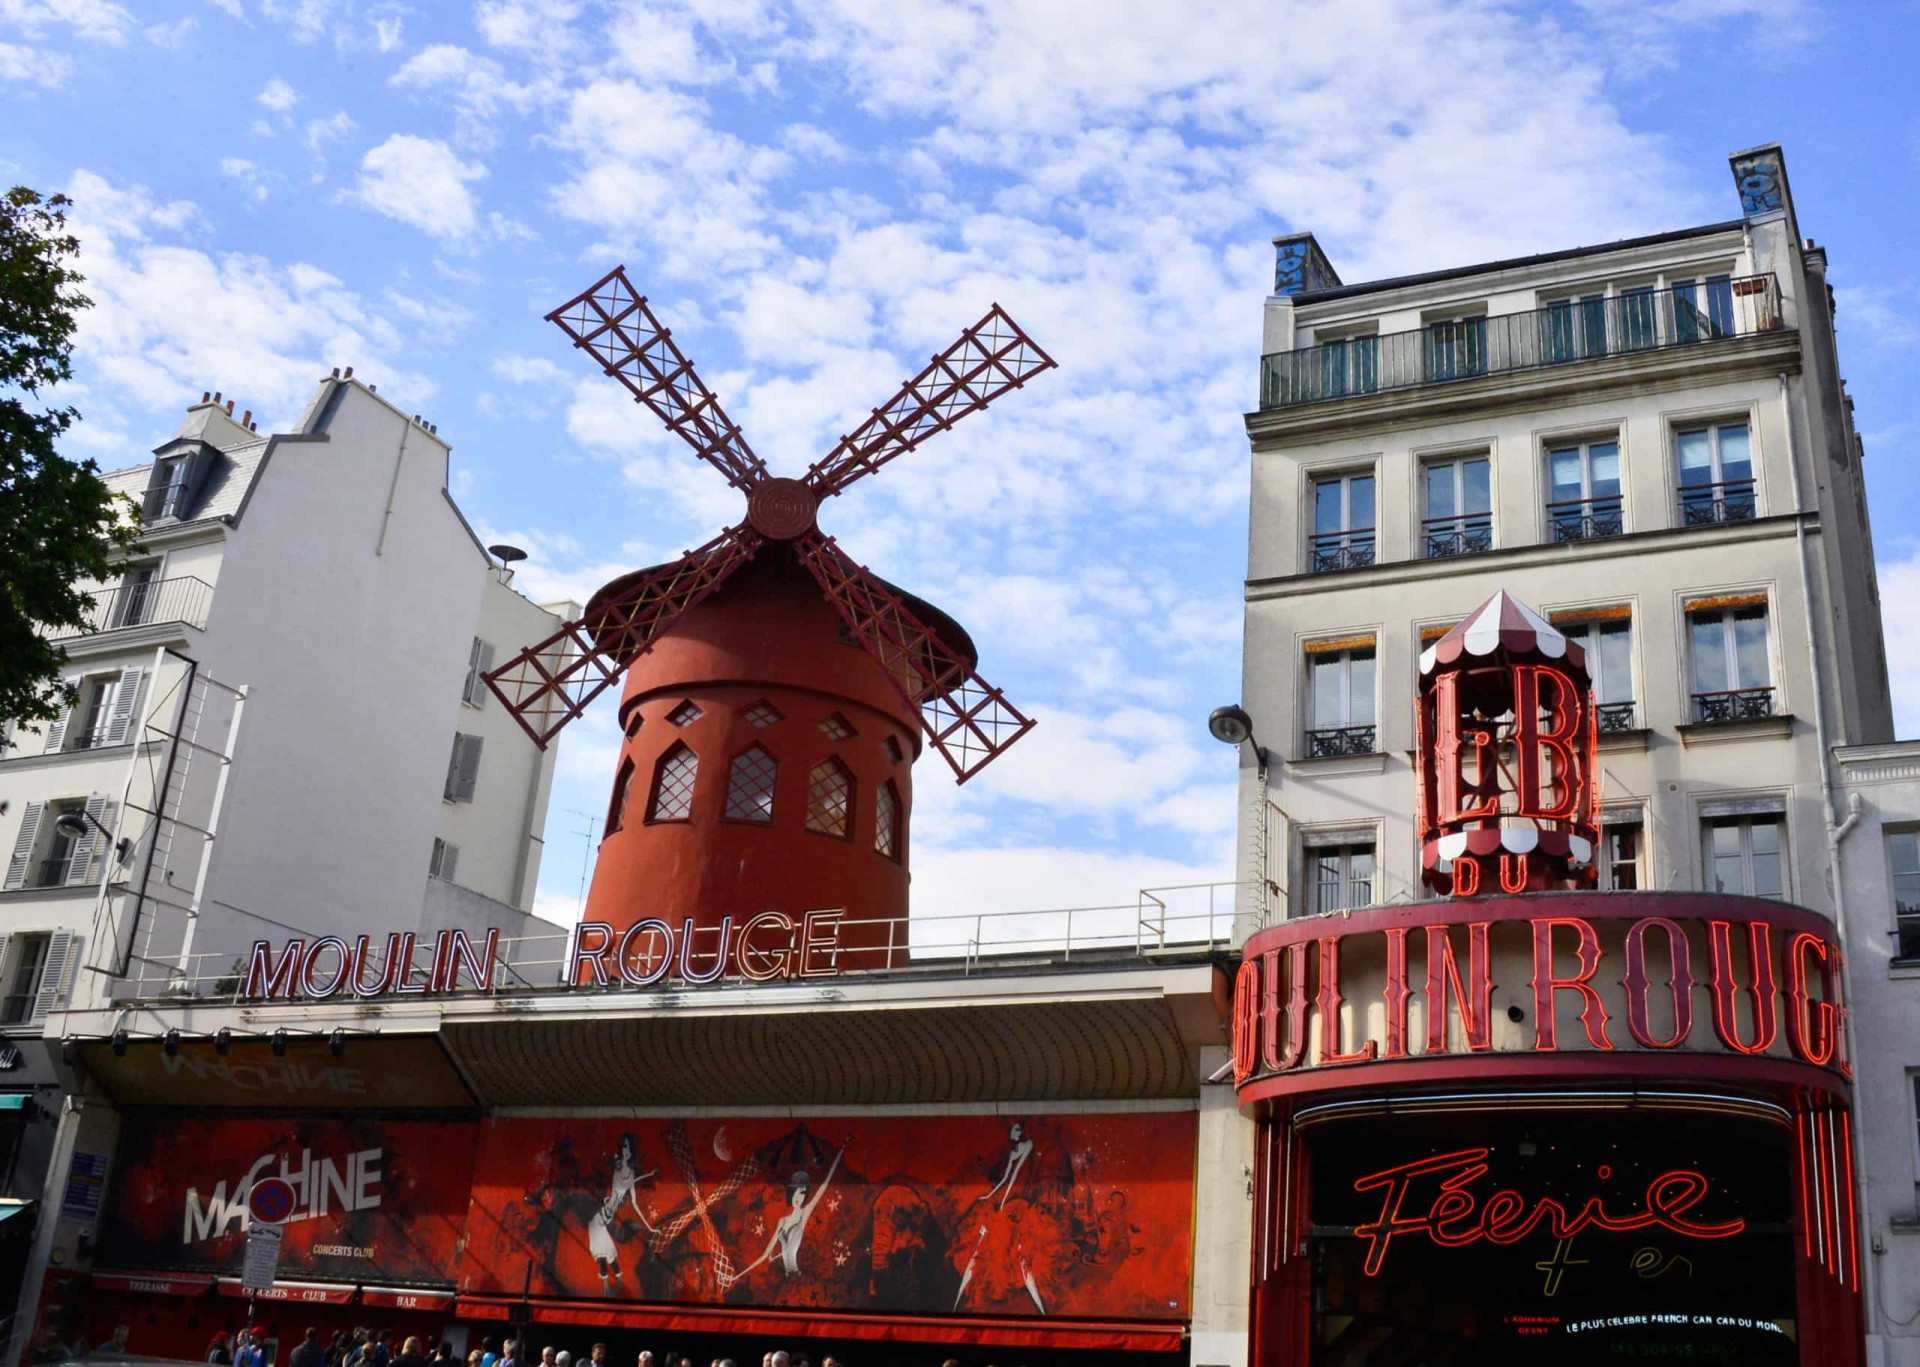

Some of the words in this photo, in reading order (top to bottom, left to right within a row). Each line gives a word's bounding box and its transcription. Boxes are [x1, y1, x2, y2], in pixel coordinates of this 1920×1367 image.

[1453, 856, 1527, 896] DU
[245, 928, 499, 999] MOULIN
[567, 906, 846, 986] ROUGE
[1233, 920, 1495, 1084] OULIN
[312, 1244, 352, 1257] CONCERTS
[354, 1247, 375, 1258] CLUB
[302, 1289, 327, 1302] CLUB
[396, 1296, 417, 1308] BAR
[1566, 1322, 1579, 1334] LE
[1580, 1318, 1606, 1331] PLUS
[1651, 1314, 1689, 1325] FRENCH
[1692, 1315, 1713, 1325] CAN
[1716, 1316, 1736, 1327] CAN
[1737, 1317, 1753, 1328] DU
